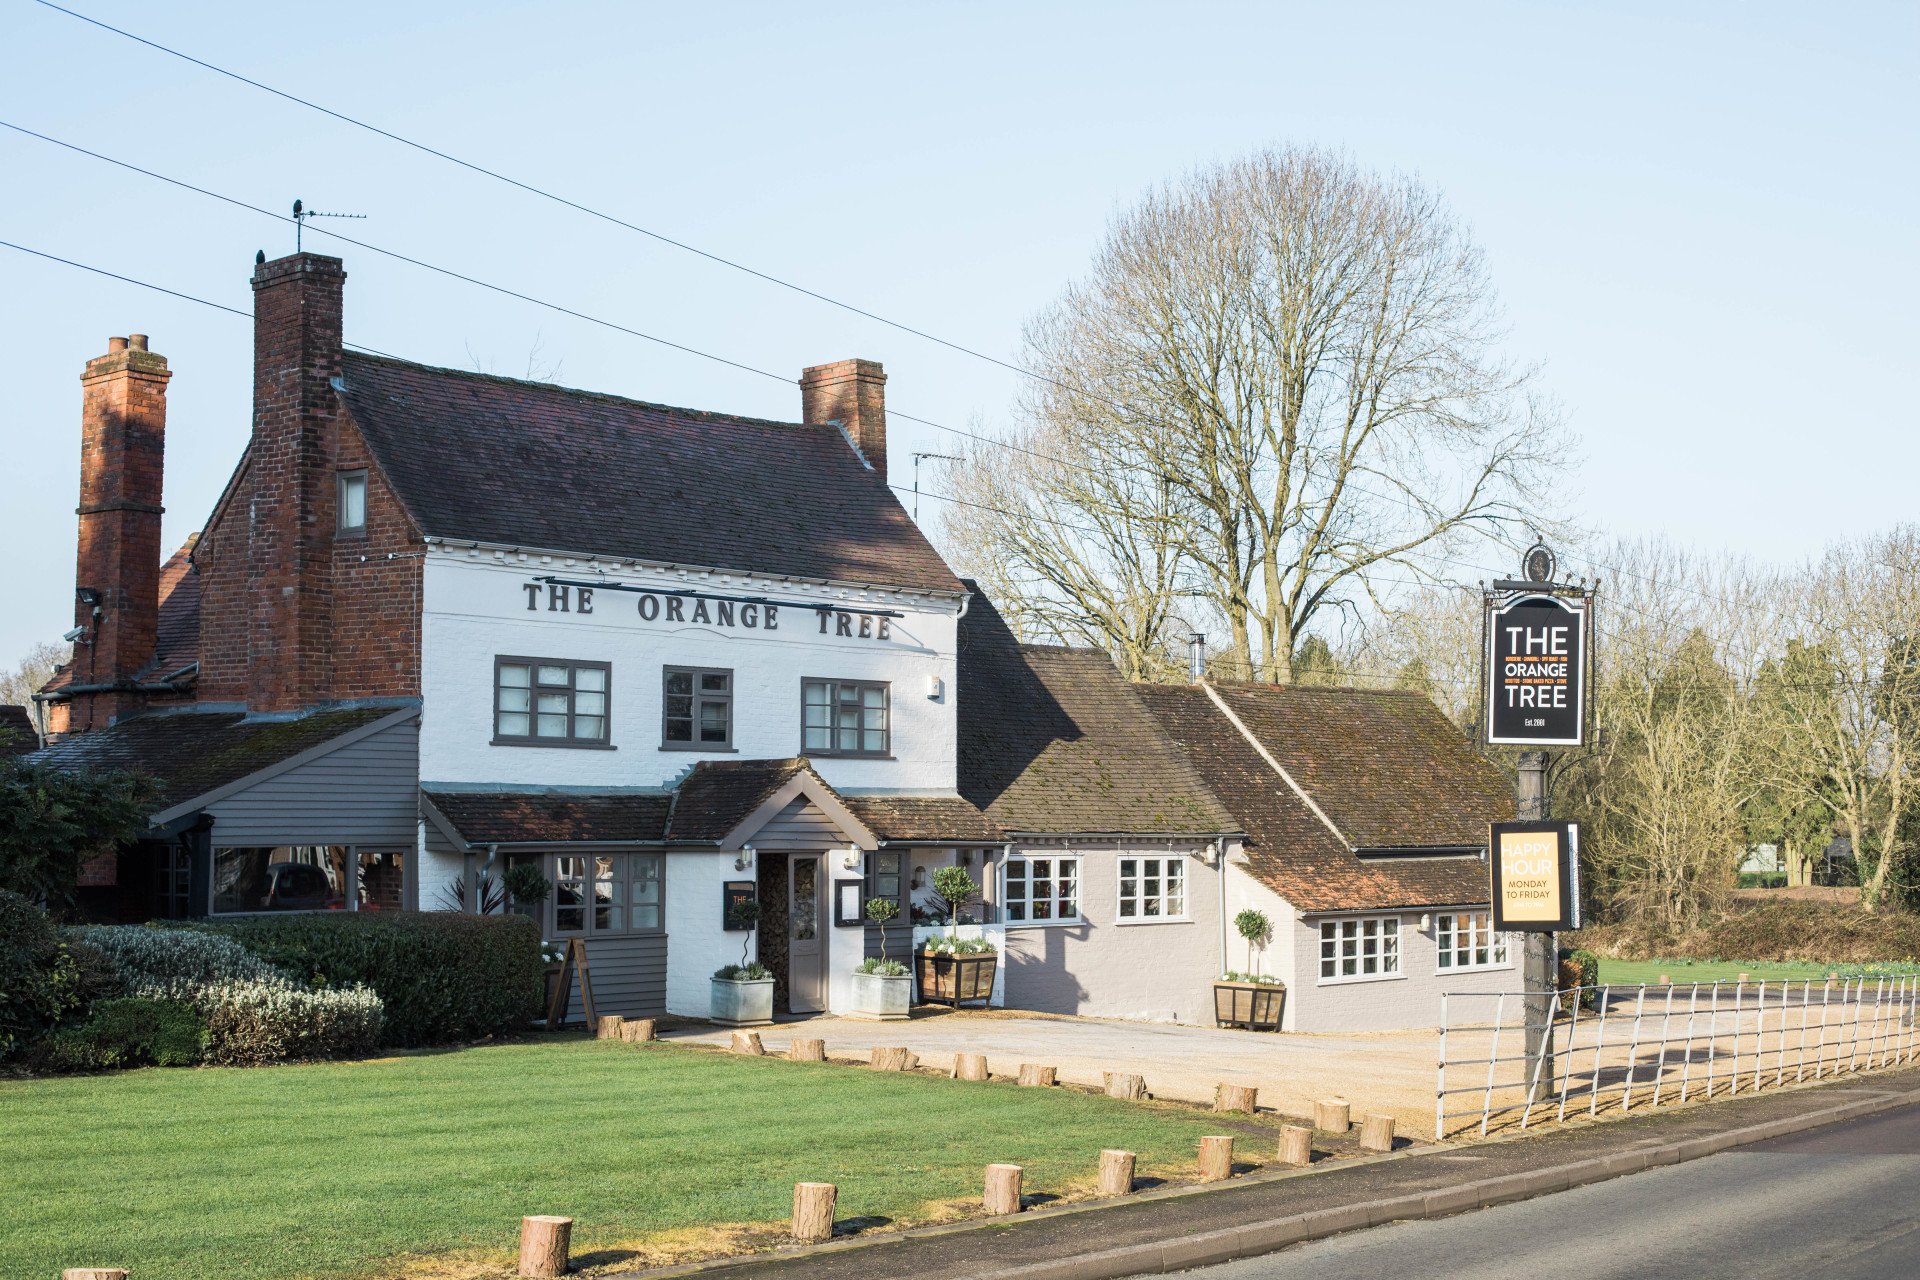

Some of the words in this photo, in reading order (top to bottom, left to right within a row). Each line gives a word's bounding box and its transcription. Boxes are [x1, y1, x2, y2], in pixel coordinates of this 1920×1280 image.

[523, 583, 594, 614] THE
[637, 594, 778, 629] ORANGE
[816, 609, 891, 641] TREE
[1506, 626, 1568, 655] THE
[1505, 663, 1568, 677] ORANGE
[1505, 685, 1567, 708] TREE
[1501, 842, 1551, 857] HAPPY
[1502, 859, 1552, 875] HOUR
[1508, 880, 1547, 888] MONDAY
[1506, 891, 1517, 899] TO
[1519, 890, 1550, 899] FRIDAY
